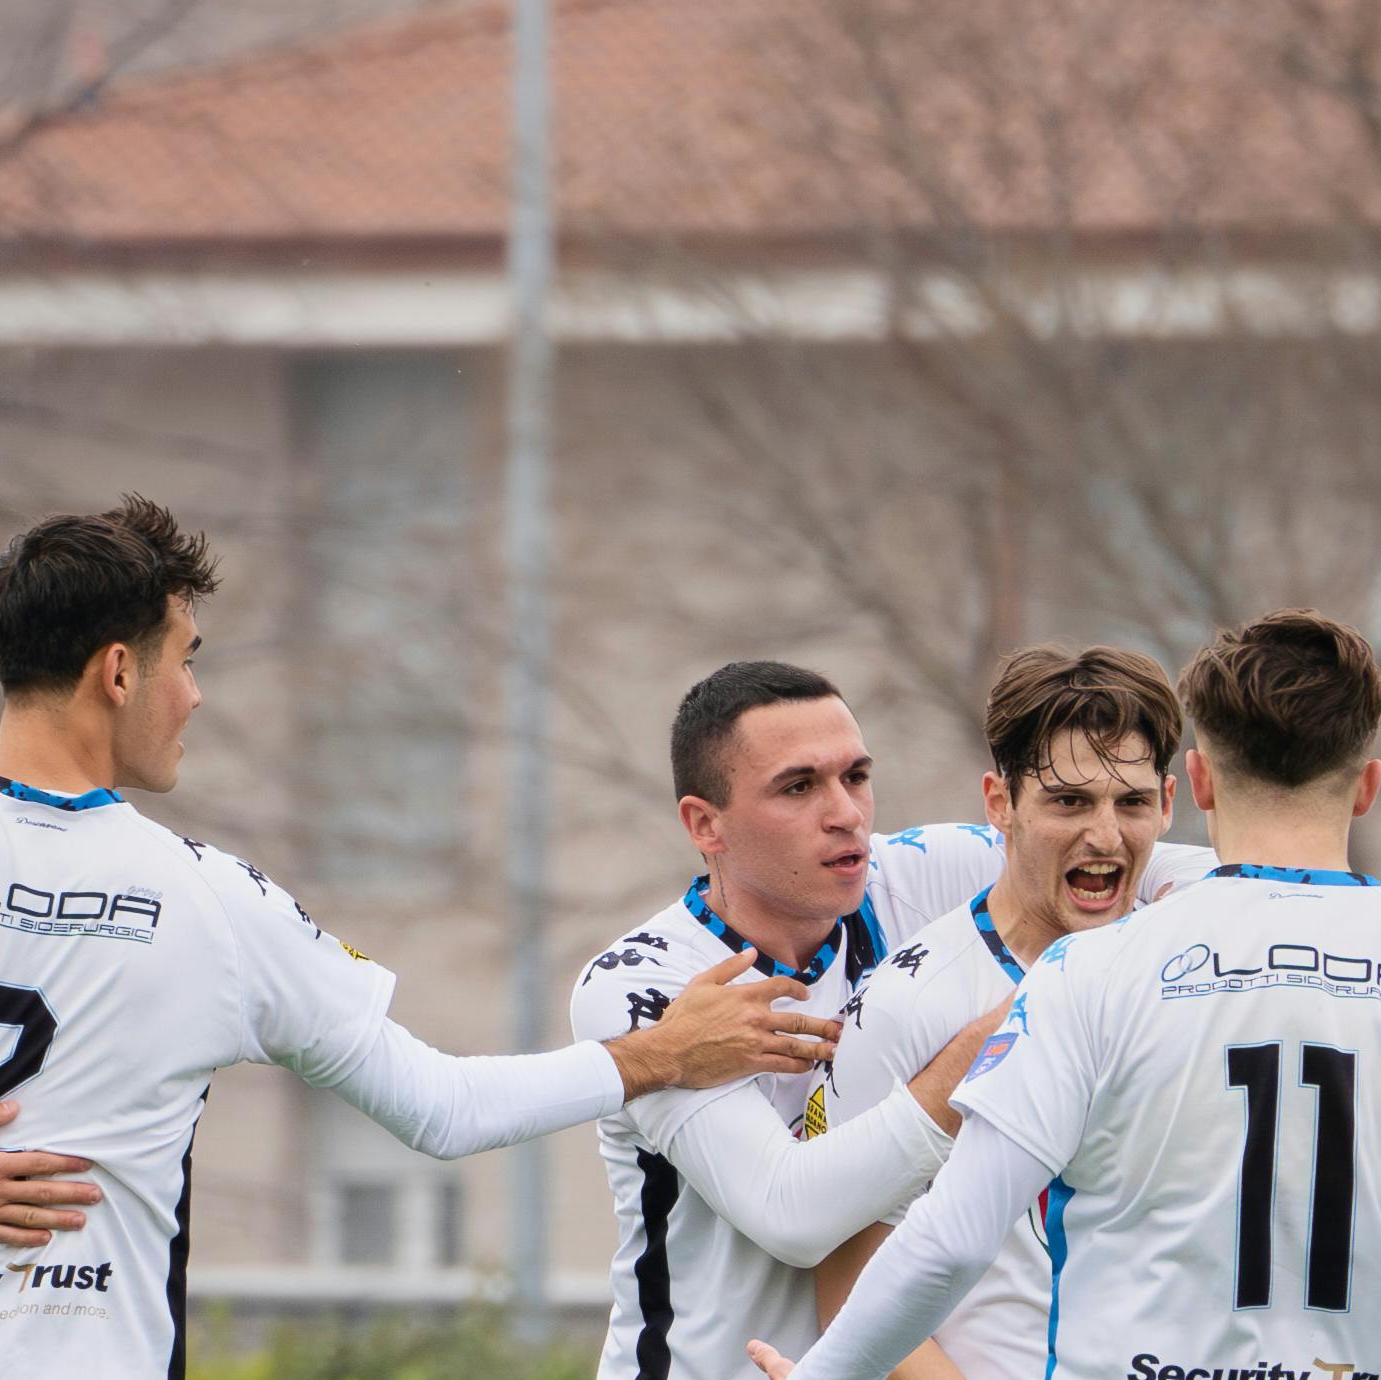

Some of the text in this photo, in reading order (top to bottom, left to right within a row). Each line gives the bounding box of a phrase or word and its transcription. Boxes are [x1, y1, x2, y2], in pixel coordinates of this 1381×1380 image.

[1161, 972, 1278, 996] PRODOTTI
[1224, 1040, 1360, 1313] 11
[6, 1261, 114, 1293] Trust
[43, 1302, 71, 1315] and
